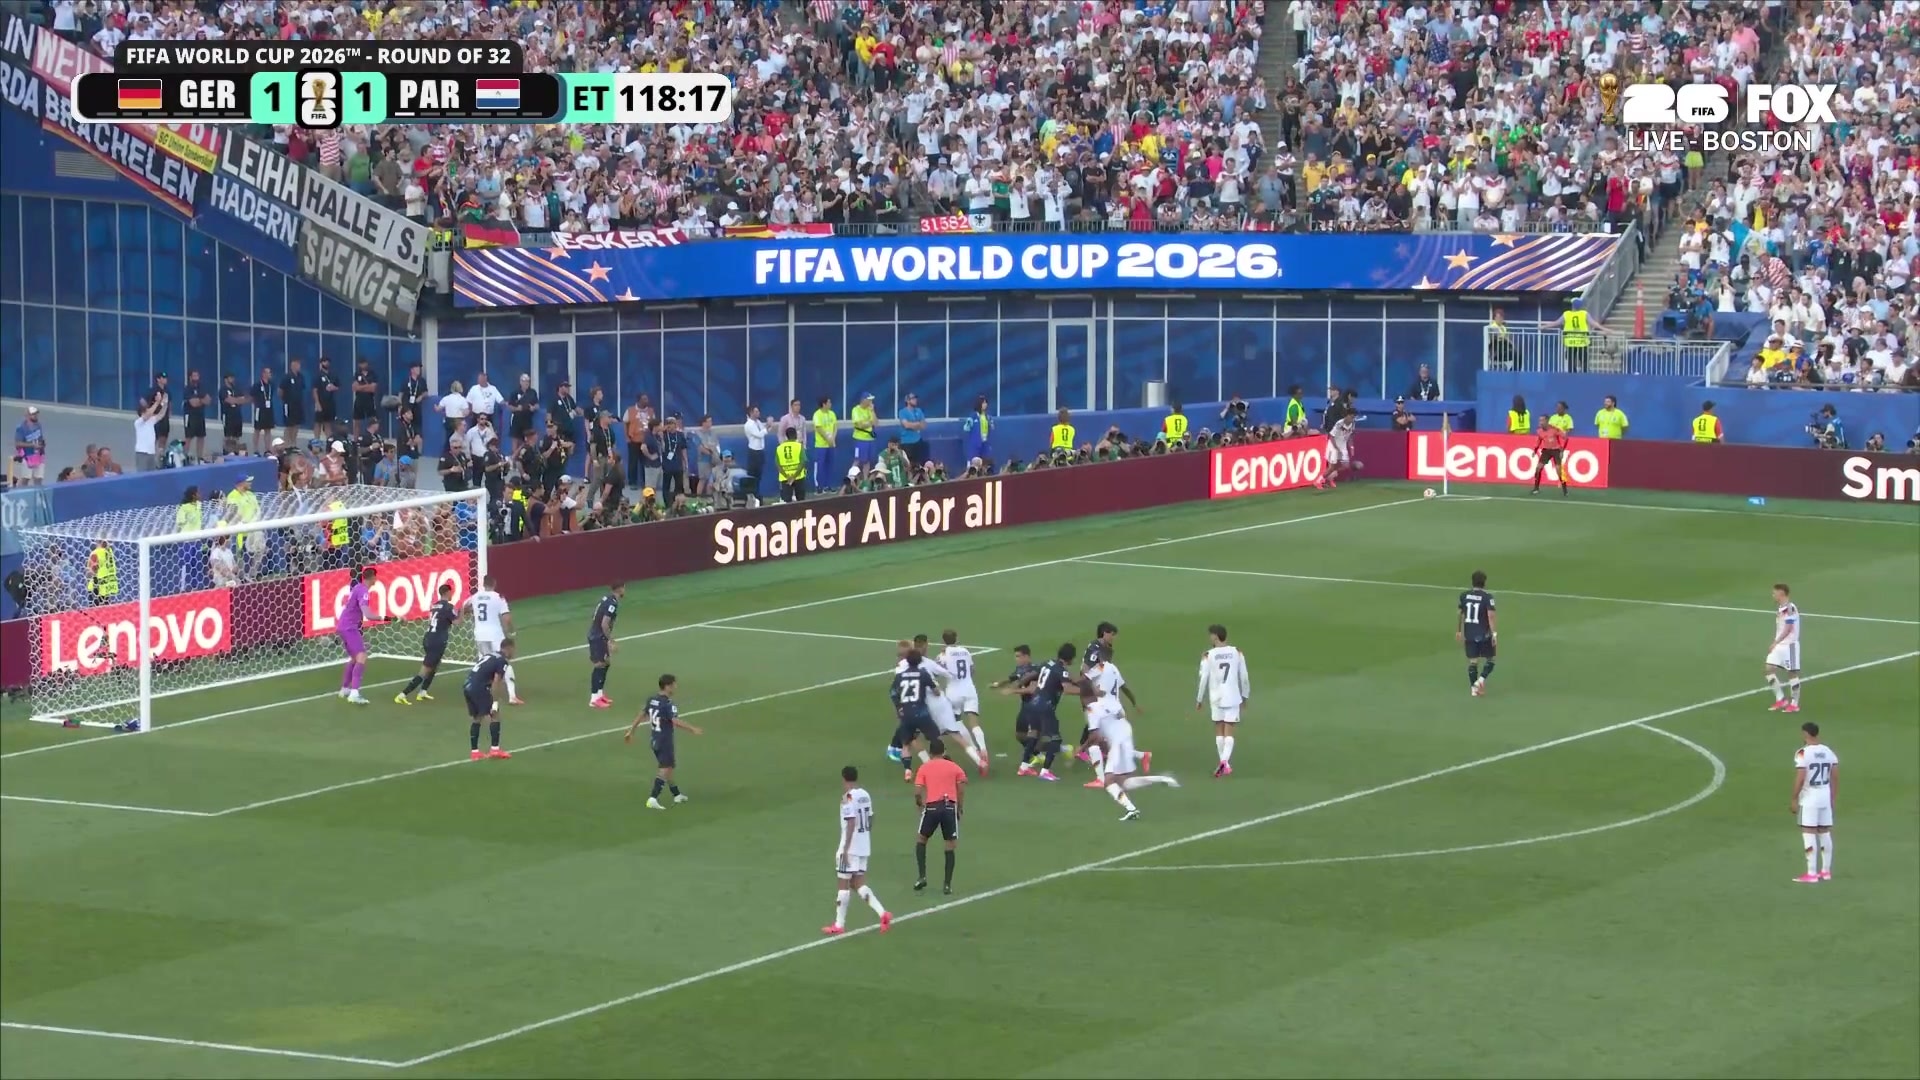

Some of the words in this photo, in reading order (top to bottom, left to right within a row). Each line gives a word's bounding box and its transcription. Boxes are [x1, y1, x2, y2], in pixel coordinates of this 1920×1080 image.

[210, 174, 299, 248] HADERN
[305, 175, 382, 245] HALLE
[397, 227, 419, 265] S.
[920, 215, 969, 233] 31582
[303, 230, 401, 317] SPENGE
[755, 248, 845, 285] FIFA
[851, 245, 1013, 282] WORLD
[1021, 243, 1110, 280] CUP
[1215, 448, 1322, 494] Lenovo
[713, 508, 852, 565] Smarter
[860, 495, 896, 544] AI
[907, 490, 956, 537] for
[964, 480, 1003, 528] all
[477, 602, 488, 622] 3
[1465, 601, 1480, 624] 11
[50, 606, 223, 672] Lenovo
[956, 659, 967, 681] 8
[1218, 662, 1231, 685] 7
[899, 678, 920, 704] 23
[648, 707, 662, 732] 14
[1808, 762, 1831, 786] 20
